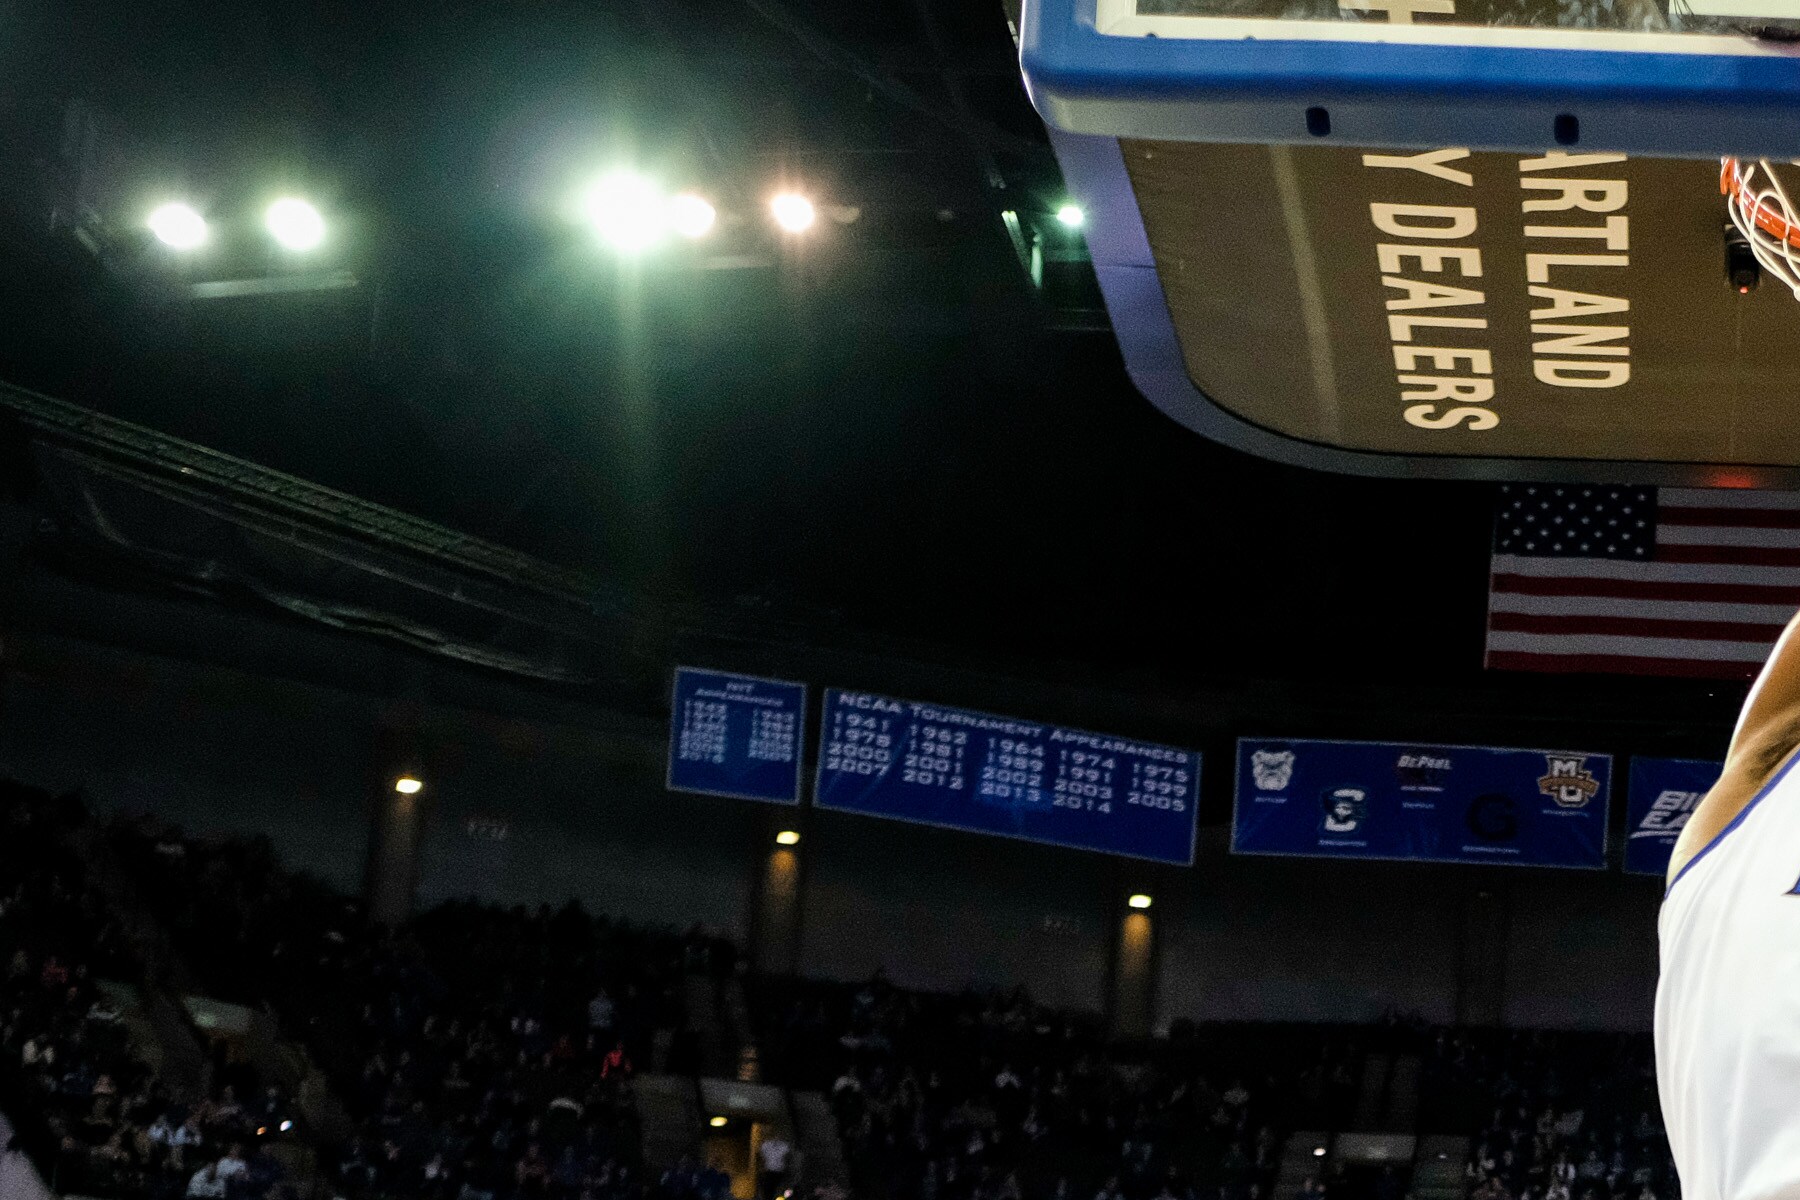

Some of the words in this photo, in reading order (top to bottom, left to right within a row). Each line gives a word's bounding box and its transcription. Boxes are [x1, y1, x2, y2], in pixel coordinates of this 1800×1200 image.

[1369, 202, 1500, 431] DEALERS
[834, 711, 890, 733] 1941
[911, 724, 967, 746] 1962
[989, 737, 1044, 757] 1964
[1060, 749, 1116, 770] 1974
[839, 694, 902, 713] NCAA
[909, 704, 1042, 737] TOURNAMENT
[1050, 729, 1188, 764] APPEARANCES
[827, 755, 891, 777] 2007
[828, 741, 890, 763] 2000
[905, 753, 962, 775] 2001
[1652, 790, 1706, 812] BI
